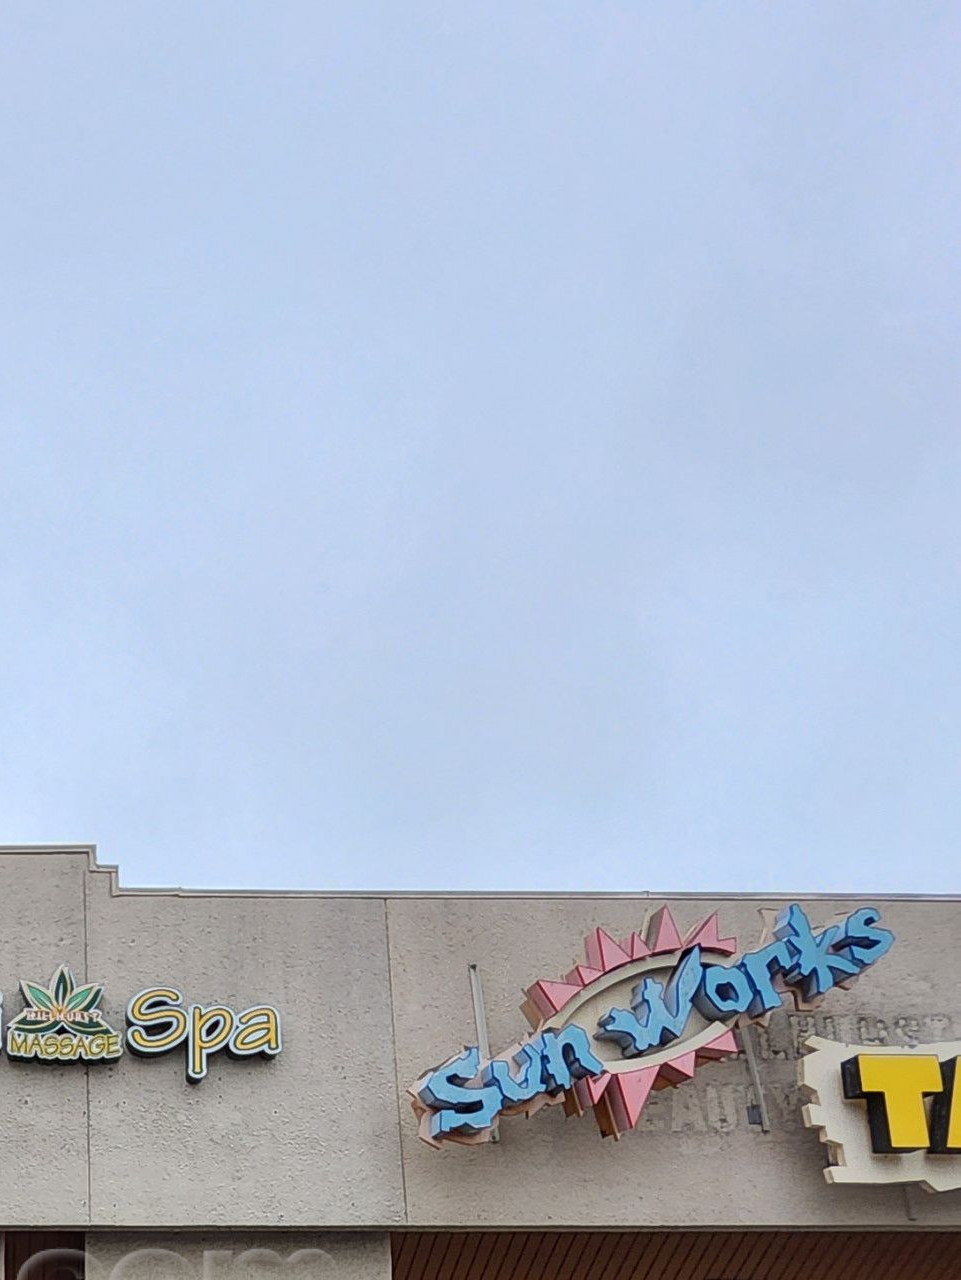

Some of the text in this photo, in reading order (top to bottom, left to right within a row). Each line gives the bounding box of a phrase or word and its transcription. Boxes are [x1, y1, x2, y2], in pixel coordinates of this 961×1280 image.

[6, 1030, 123, 1061] MASSAGE
[127, 986, 283, 1082] Spa
[418, 1024, 605, 1140] Sun
[594, 902, 896, 1060] Works
